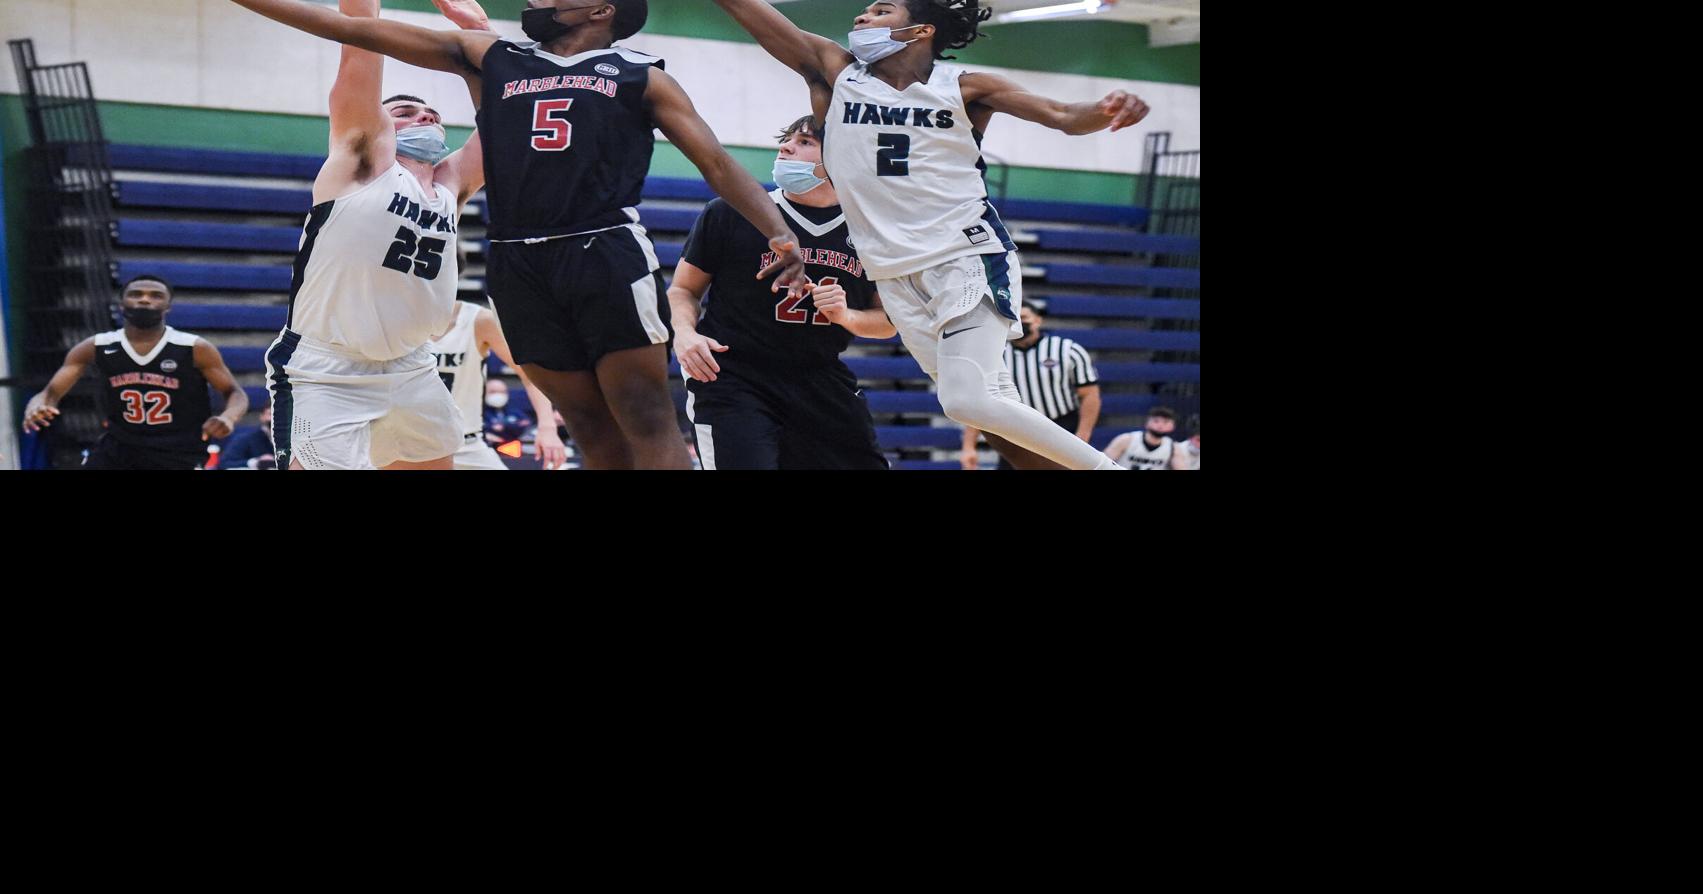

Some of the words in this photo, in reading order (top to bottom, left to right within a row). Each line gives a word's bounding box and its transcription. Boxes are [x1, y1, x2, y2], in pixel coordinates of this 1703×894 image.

[502, 75, 618, 99] MARBLEHEAD
[530, 98, 574, 151] 5
[842, 101, 955, 129] HAWKS
[876, 132, 911, 177] 2
[381, 225, 447, 280] 25
[760, 247, 863, 278] MBLEHEAD
[120, 389, 173, 425] 32
